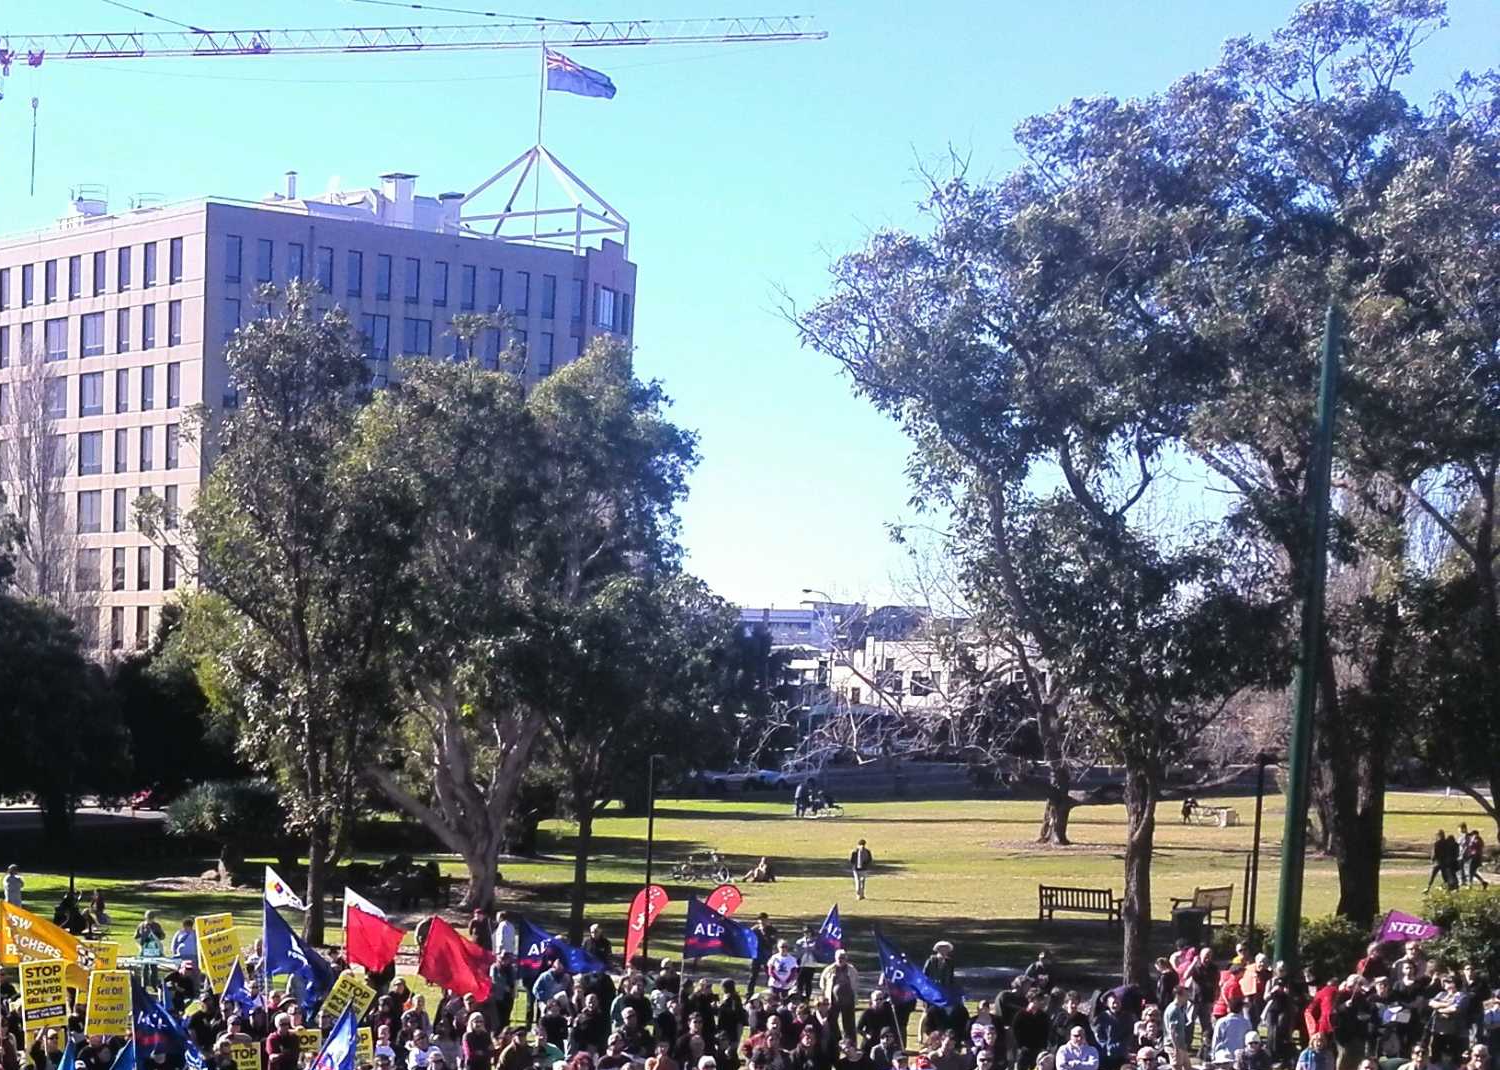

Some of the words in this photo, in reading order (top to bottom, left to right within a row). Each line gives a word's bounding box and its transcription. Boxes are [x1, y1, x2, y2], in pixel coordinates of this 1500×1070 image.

[8, 912, 33, 930] SW
[1387, 921, 1428, 936] NTEU
[694, 922, 725, 937] ALP
[4, 926, 63, 958] TACHERS
[25, 964, 62, 978] STOP
[26, 985, 62, 996] POWER
[97, 986, 111, 995] Sell
[111, 986, 123, 995] Off
[340, 979, 371, 999] STOP
[233, 1049, 258, 1060] TOP
